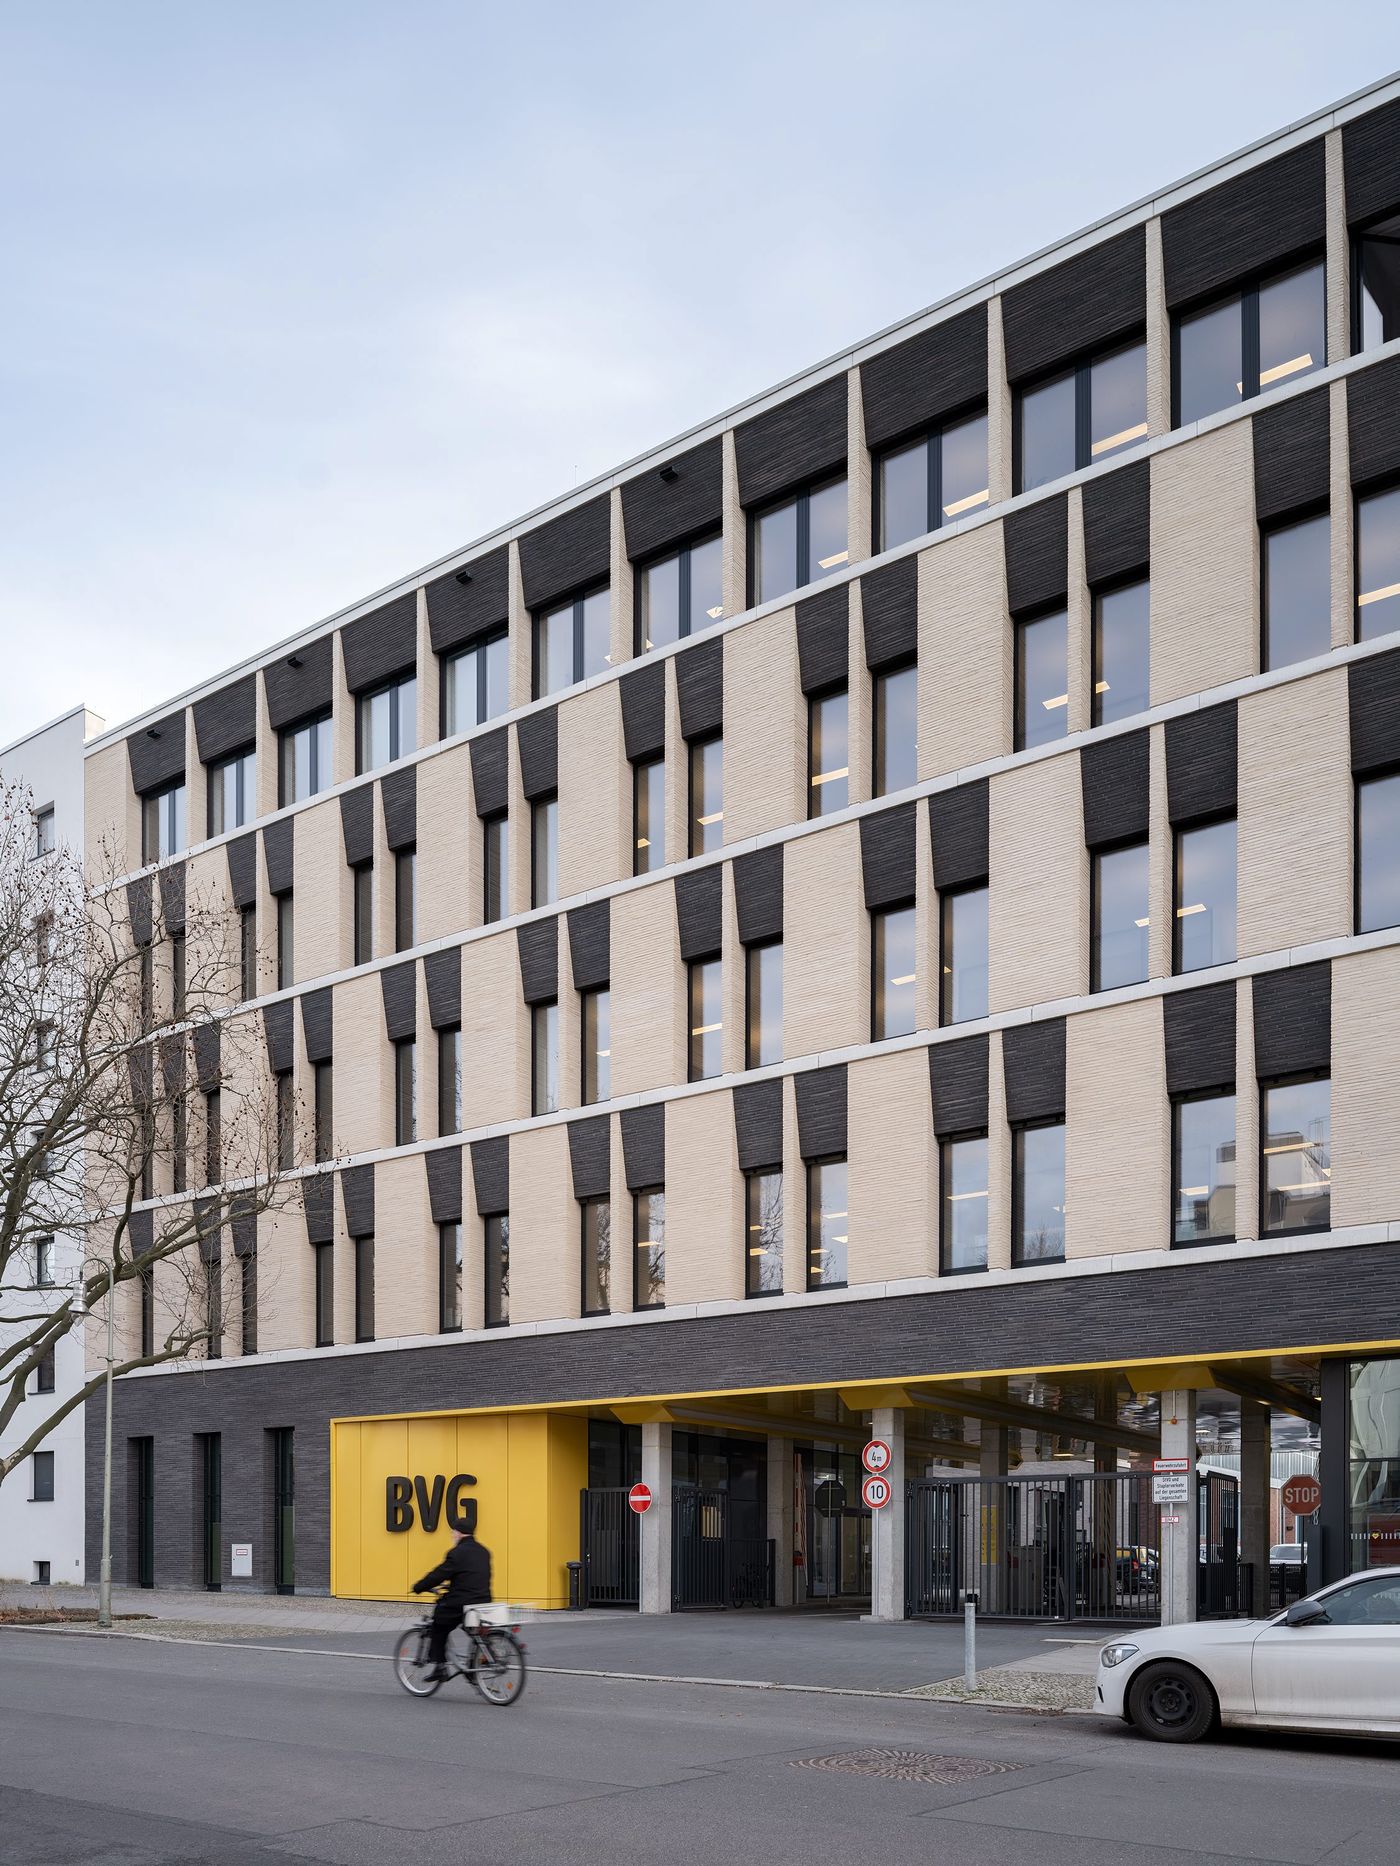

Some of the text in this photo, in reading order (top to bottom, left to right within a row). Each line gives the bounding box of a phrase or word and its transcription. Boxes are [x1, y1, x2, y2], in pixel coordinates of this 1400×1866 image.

[870, 1485, 884, 1499] 10
[1285, 1487, 1319, 1504] STOP
[386, 1473, 478, 1533] BVG
